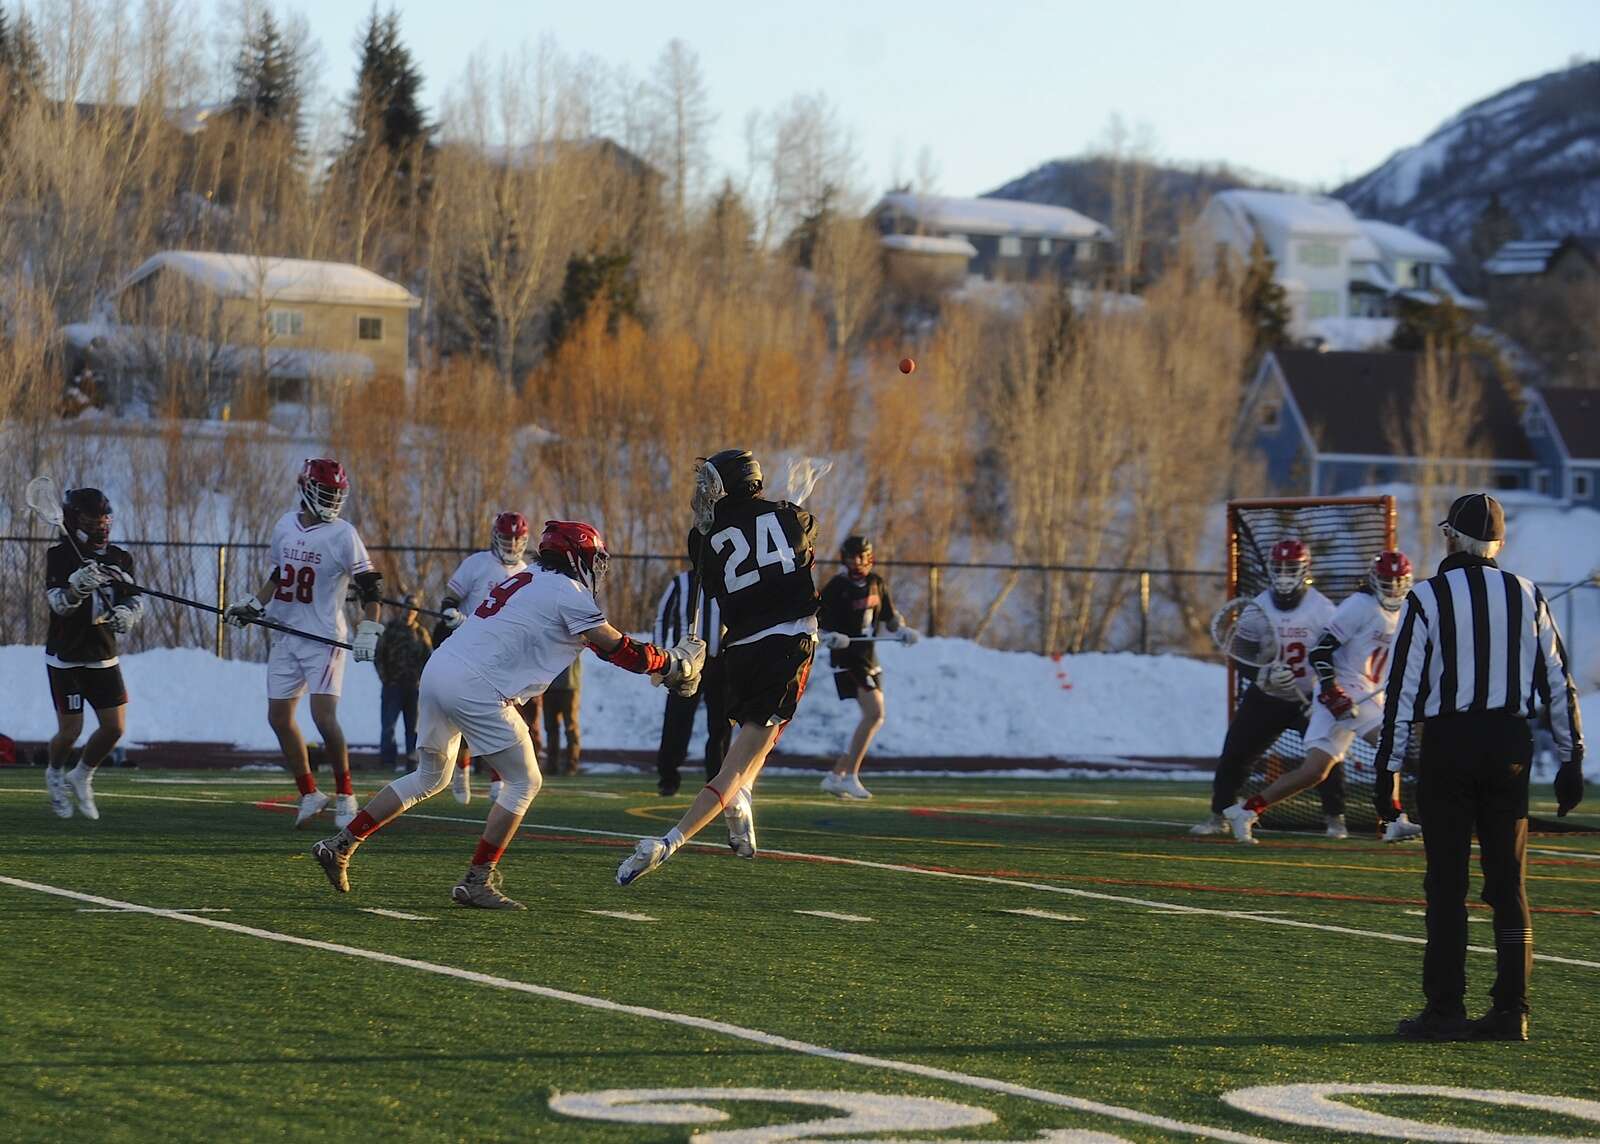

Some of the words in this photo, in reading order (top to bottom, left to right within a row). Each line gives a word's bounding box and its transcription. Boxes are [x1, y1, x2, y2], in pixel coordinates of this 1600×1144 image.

[282, 547, 322, 565] SILORS
[710, 511, 796, 593] 24
[274, 563, 316, 604] 28
[474, 572, 534, 619] 9
[66, 694, 81, 710] 10
